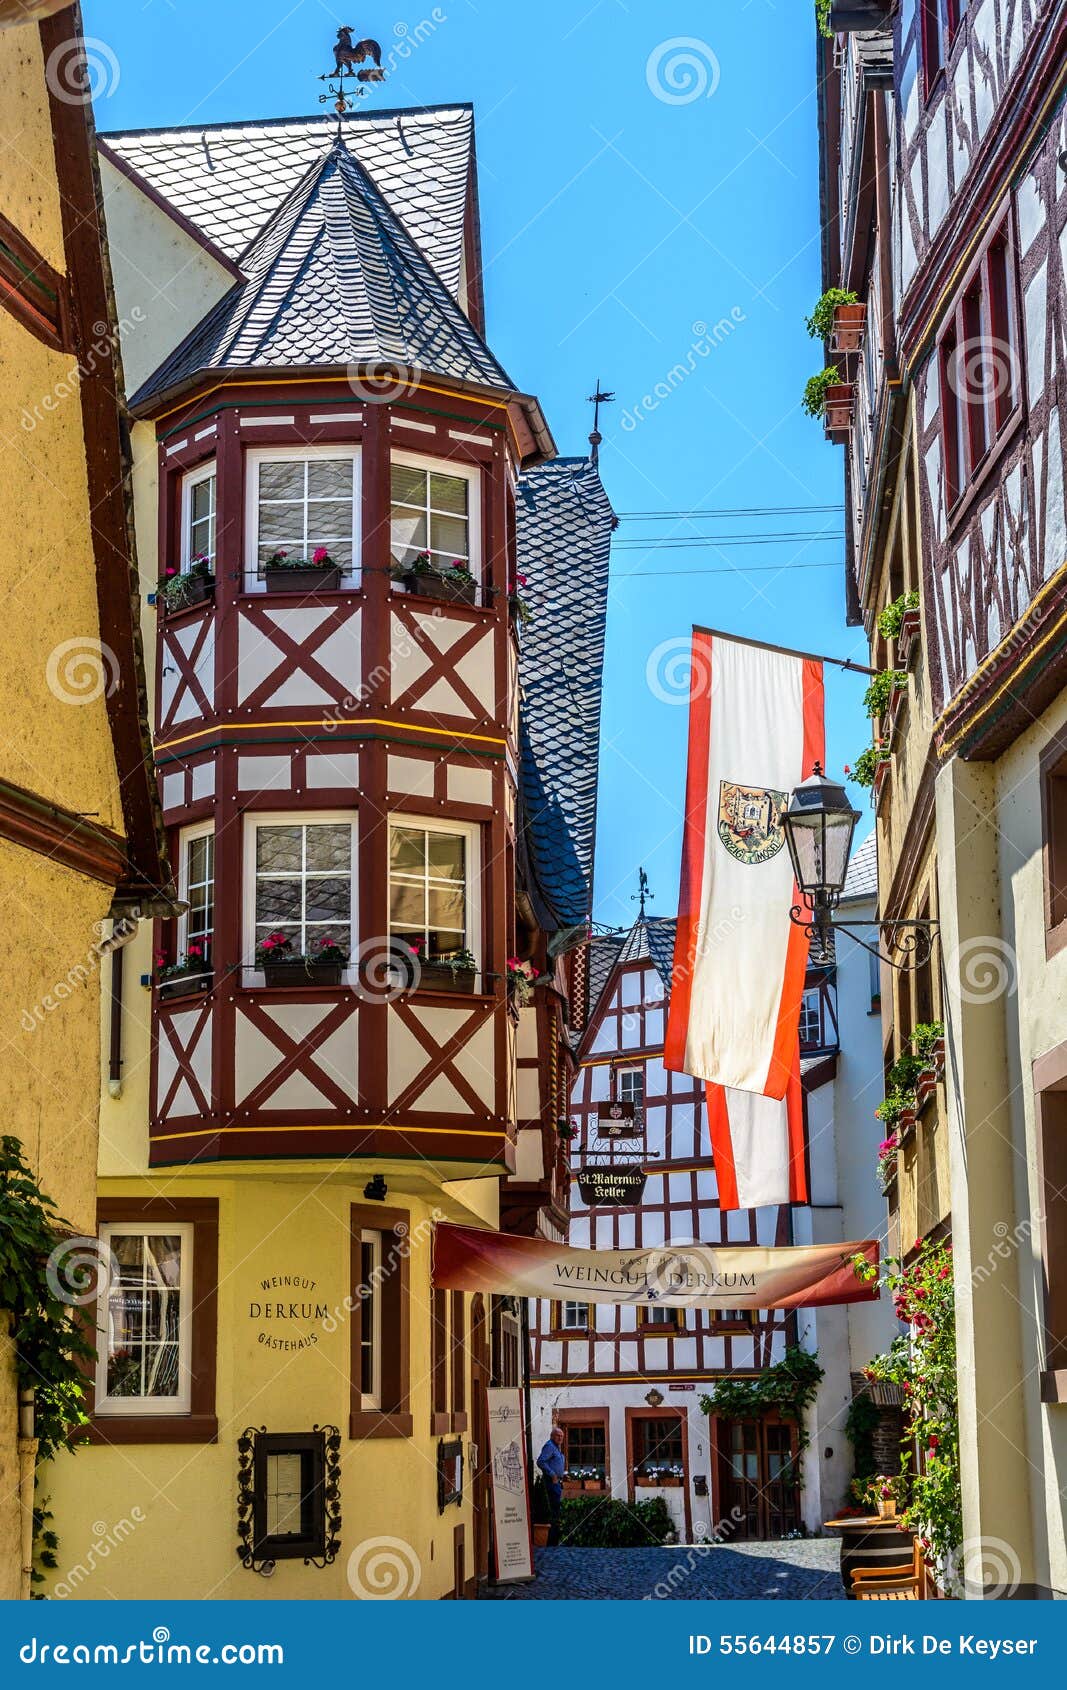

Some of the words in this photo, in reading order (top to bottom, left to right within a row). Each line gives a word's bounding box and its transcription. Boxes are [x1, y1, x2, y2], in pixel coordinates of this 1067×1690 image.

[594, 1186, 626, 1197] Keller
[556, 1264, 650, 1286] WEINGUT
[669, 1272, 756, 1287] DERKUM
[260, 1276, 316, 1291] WEINGUT
[249, 1303, 329, 1319] DERKUM
